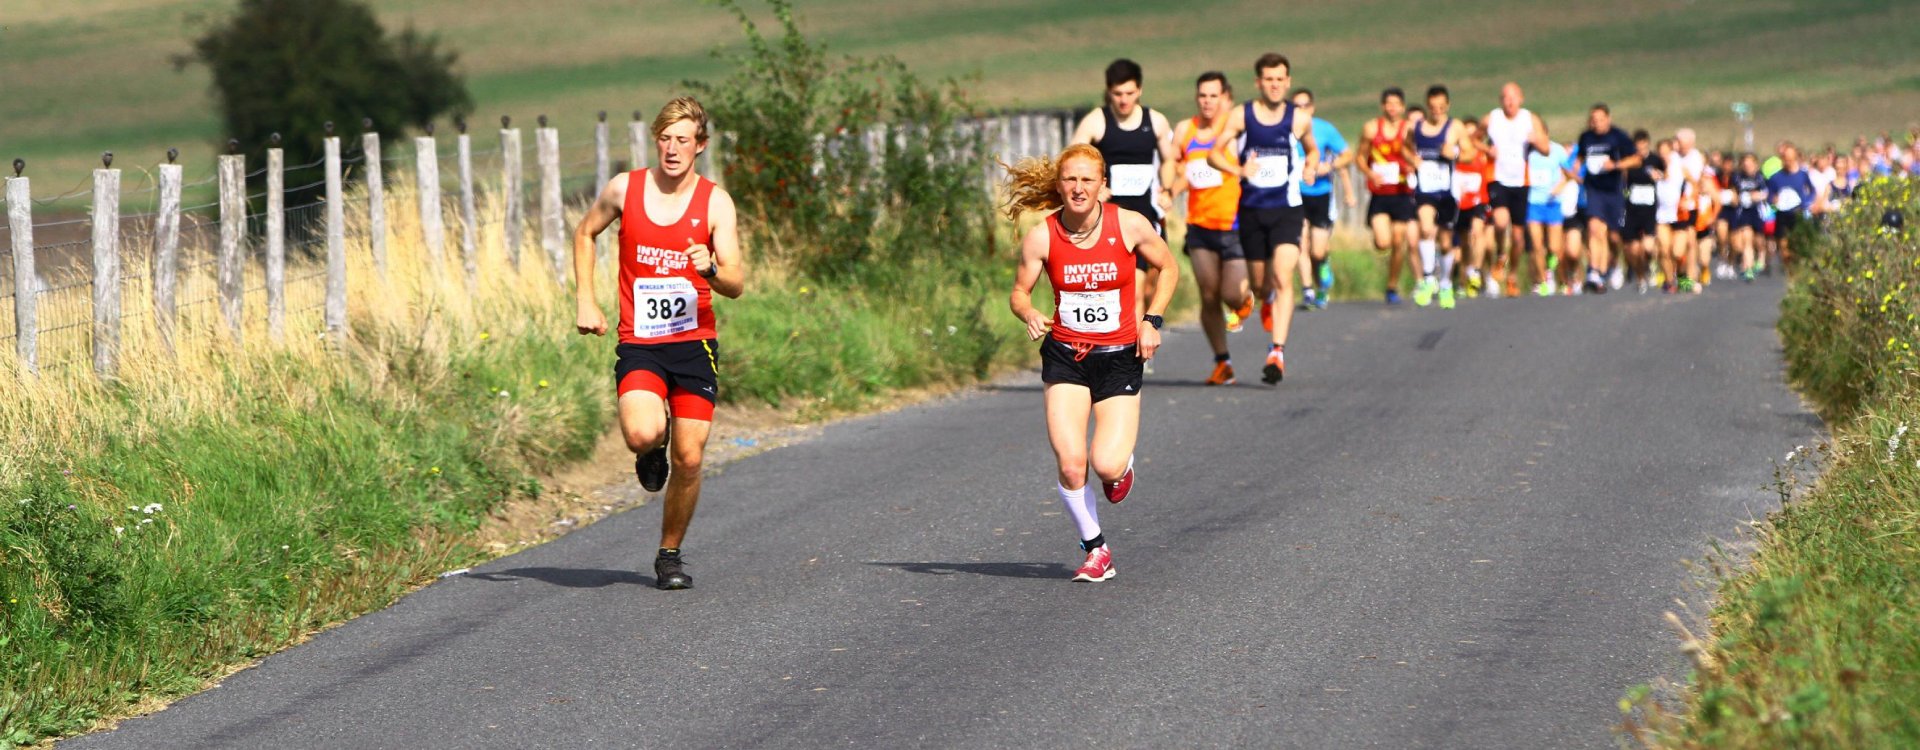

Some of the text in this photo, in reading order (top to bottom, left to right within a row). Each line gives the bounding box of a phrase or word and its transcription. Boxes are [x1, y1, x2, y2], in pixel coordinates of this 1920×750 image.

[637, 255, 688, 269] EAST KENT
[1064, 262, 1118, 274] INVICTA
[655, 266, 669, 275] AC
[1064, 272, 1118, 284] EAST KENT
[647, 297, 687, 320] 382
[1073, 307, 1108, 323] 163
